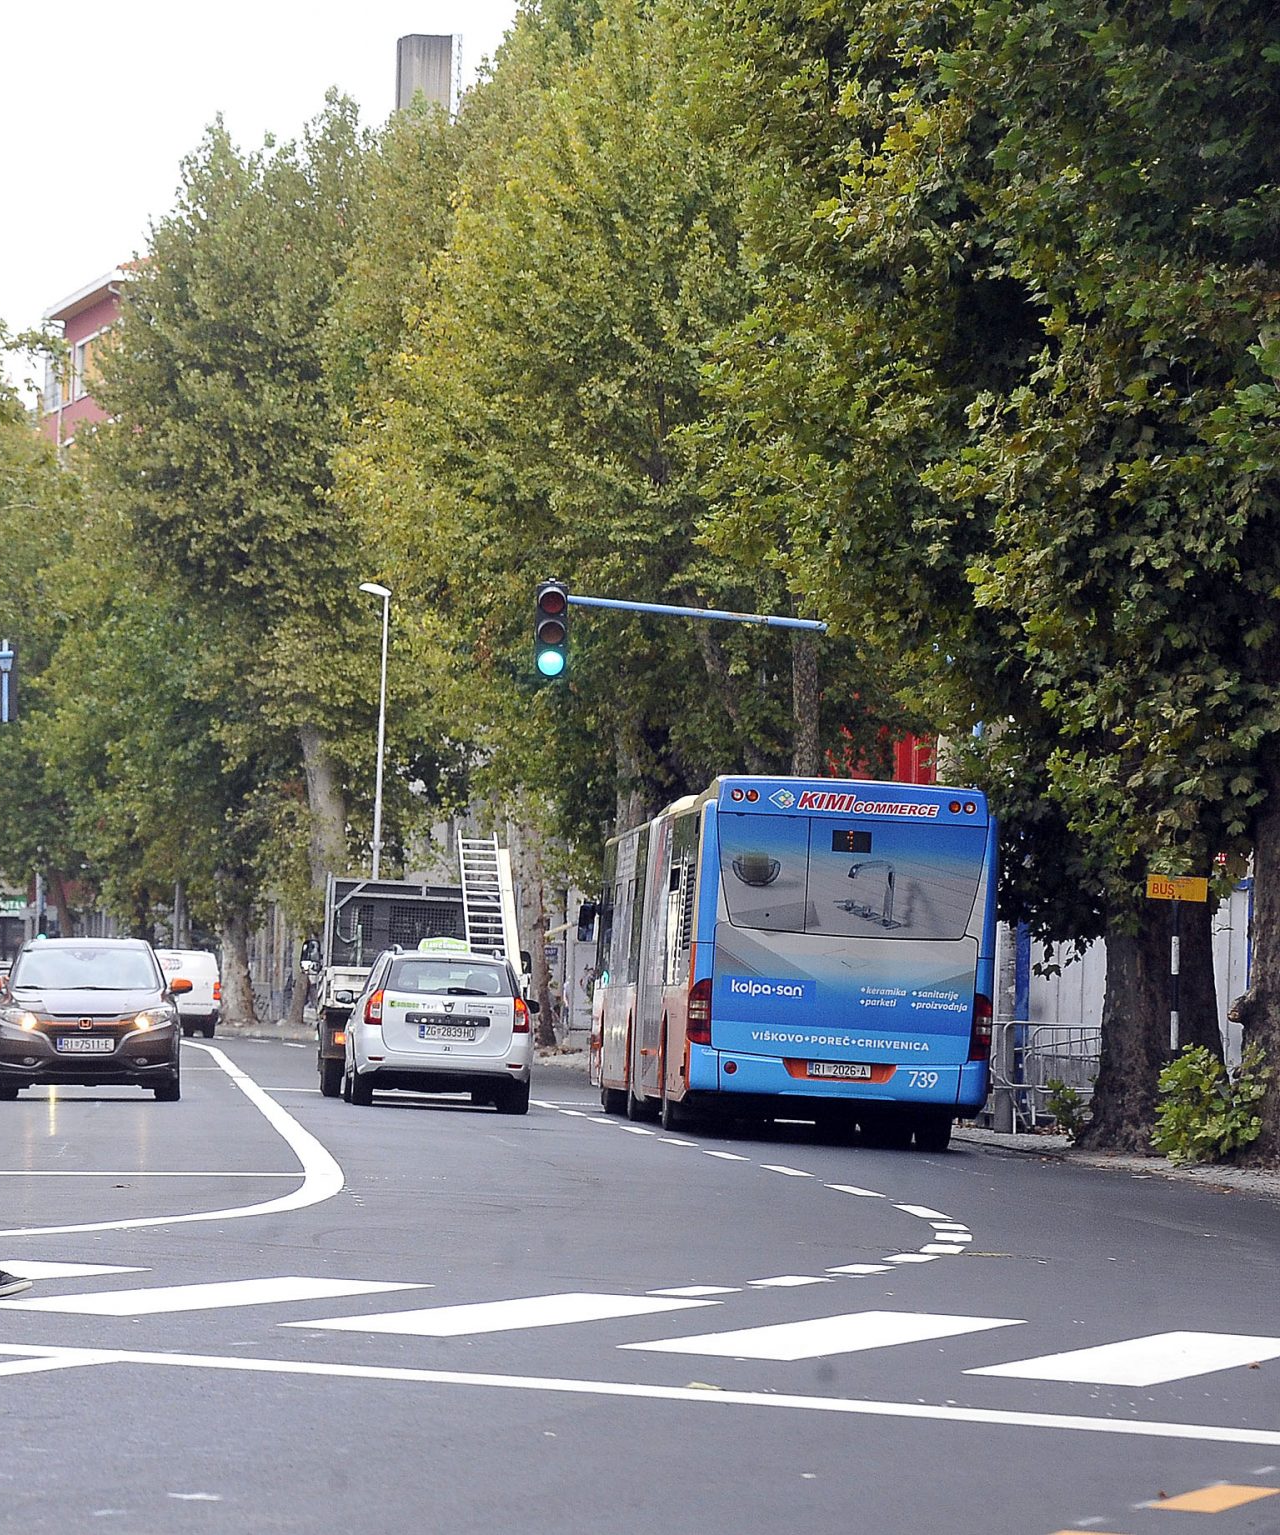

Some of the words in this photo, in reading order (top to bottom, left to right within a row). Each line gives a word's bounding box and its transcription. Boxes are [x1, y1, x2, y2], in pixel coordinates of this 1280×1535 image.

[797, 790, 856, 812] KIMI
[854, 802, 939, 817] COMMERCE
[1152, 882, 1175, 896] BUS
[865, 986, 907, 997] keramika
[917, 989, 959, 1001] sanitarije
[864, 998, 897, 1007] parketi
[915, 1001, 968, 1013] proizvodnja
[426, 1025, 437, 1036] ZG
[63, 1039, 73, 1050] RI
[751, 1030, 806, 1043] VIŠKOVO
[810, 1035, 851, 1046] POREČ
[856, 1038, 930, 1051] CRIKVENICA
[814, 1063, 825, 1074] RI
[832, 1064, 867, 1076] 2026-A
[908, 1071, 939, 1089] 739
